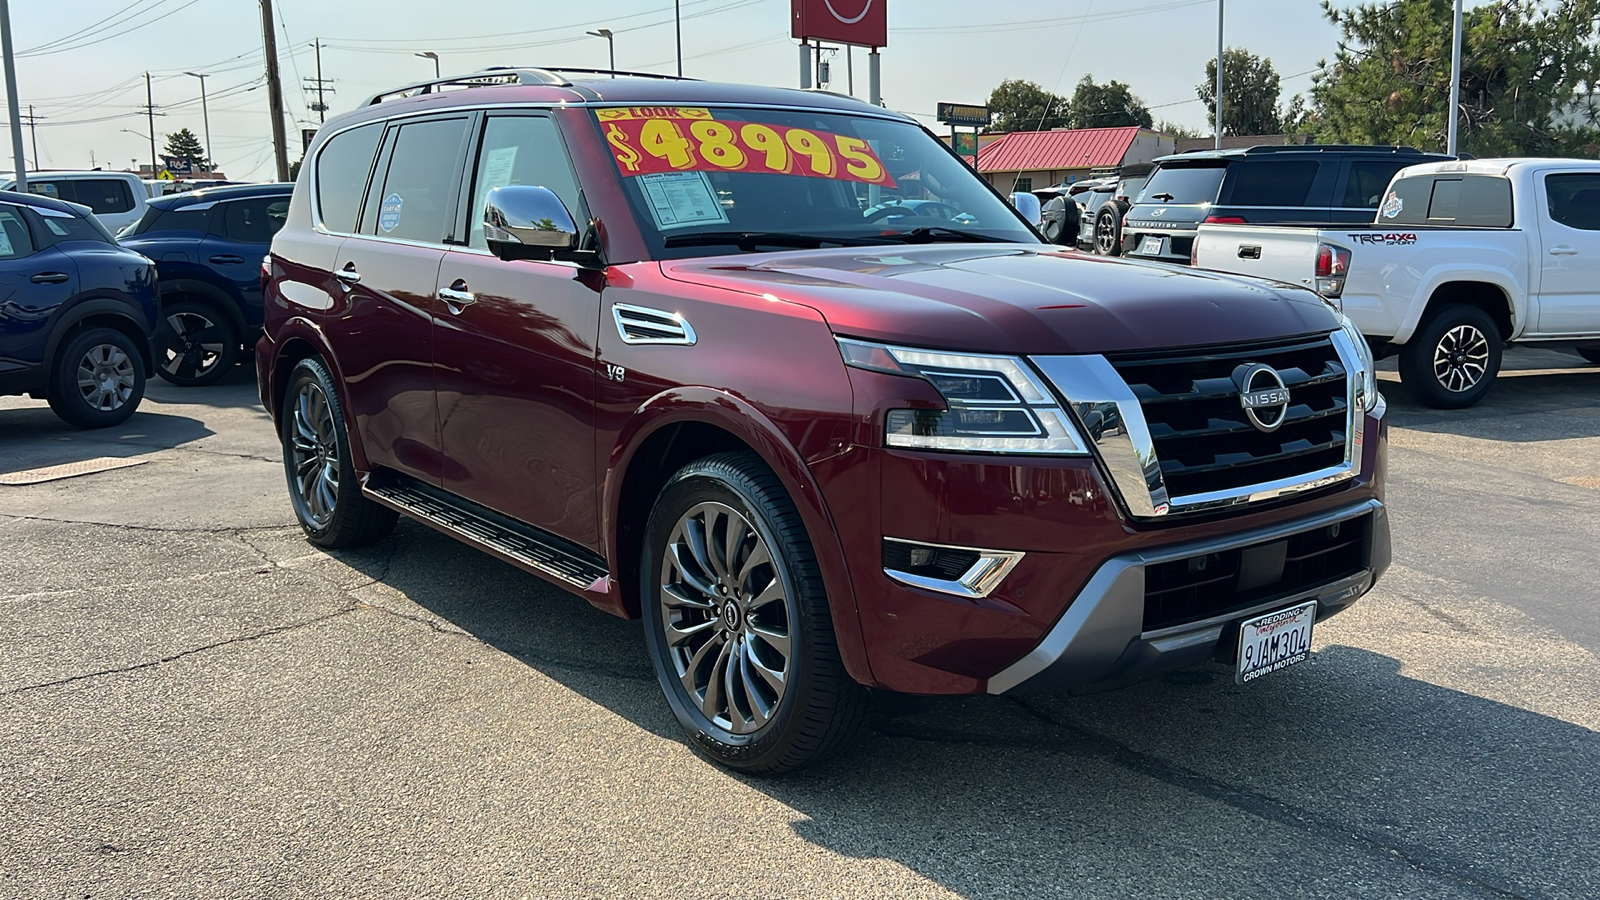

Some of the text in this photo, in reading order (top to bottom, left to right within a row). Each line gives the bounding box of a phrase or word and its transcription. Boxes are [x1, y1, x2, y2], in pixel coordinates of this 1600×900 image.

[628, 107, 684, 118] LOOK
[169, 160, 188, 169] RAC
[606, 364, 625, 382] V8
[1242, 391, 1290, 406] NISSAN
[1260, 608, 1300, 626] REDDING
[1241, 626, 1306, 673] 9JAM304
[1243, 652, 1306, 682] CROWN MOTORS
